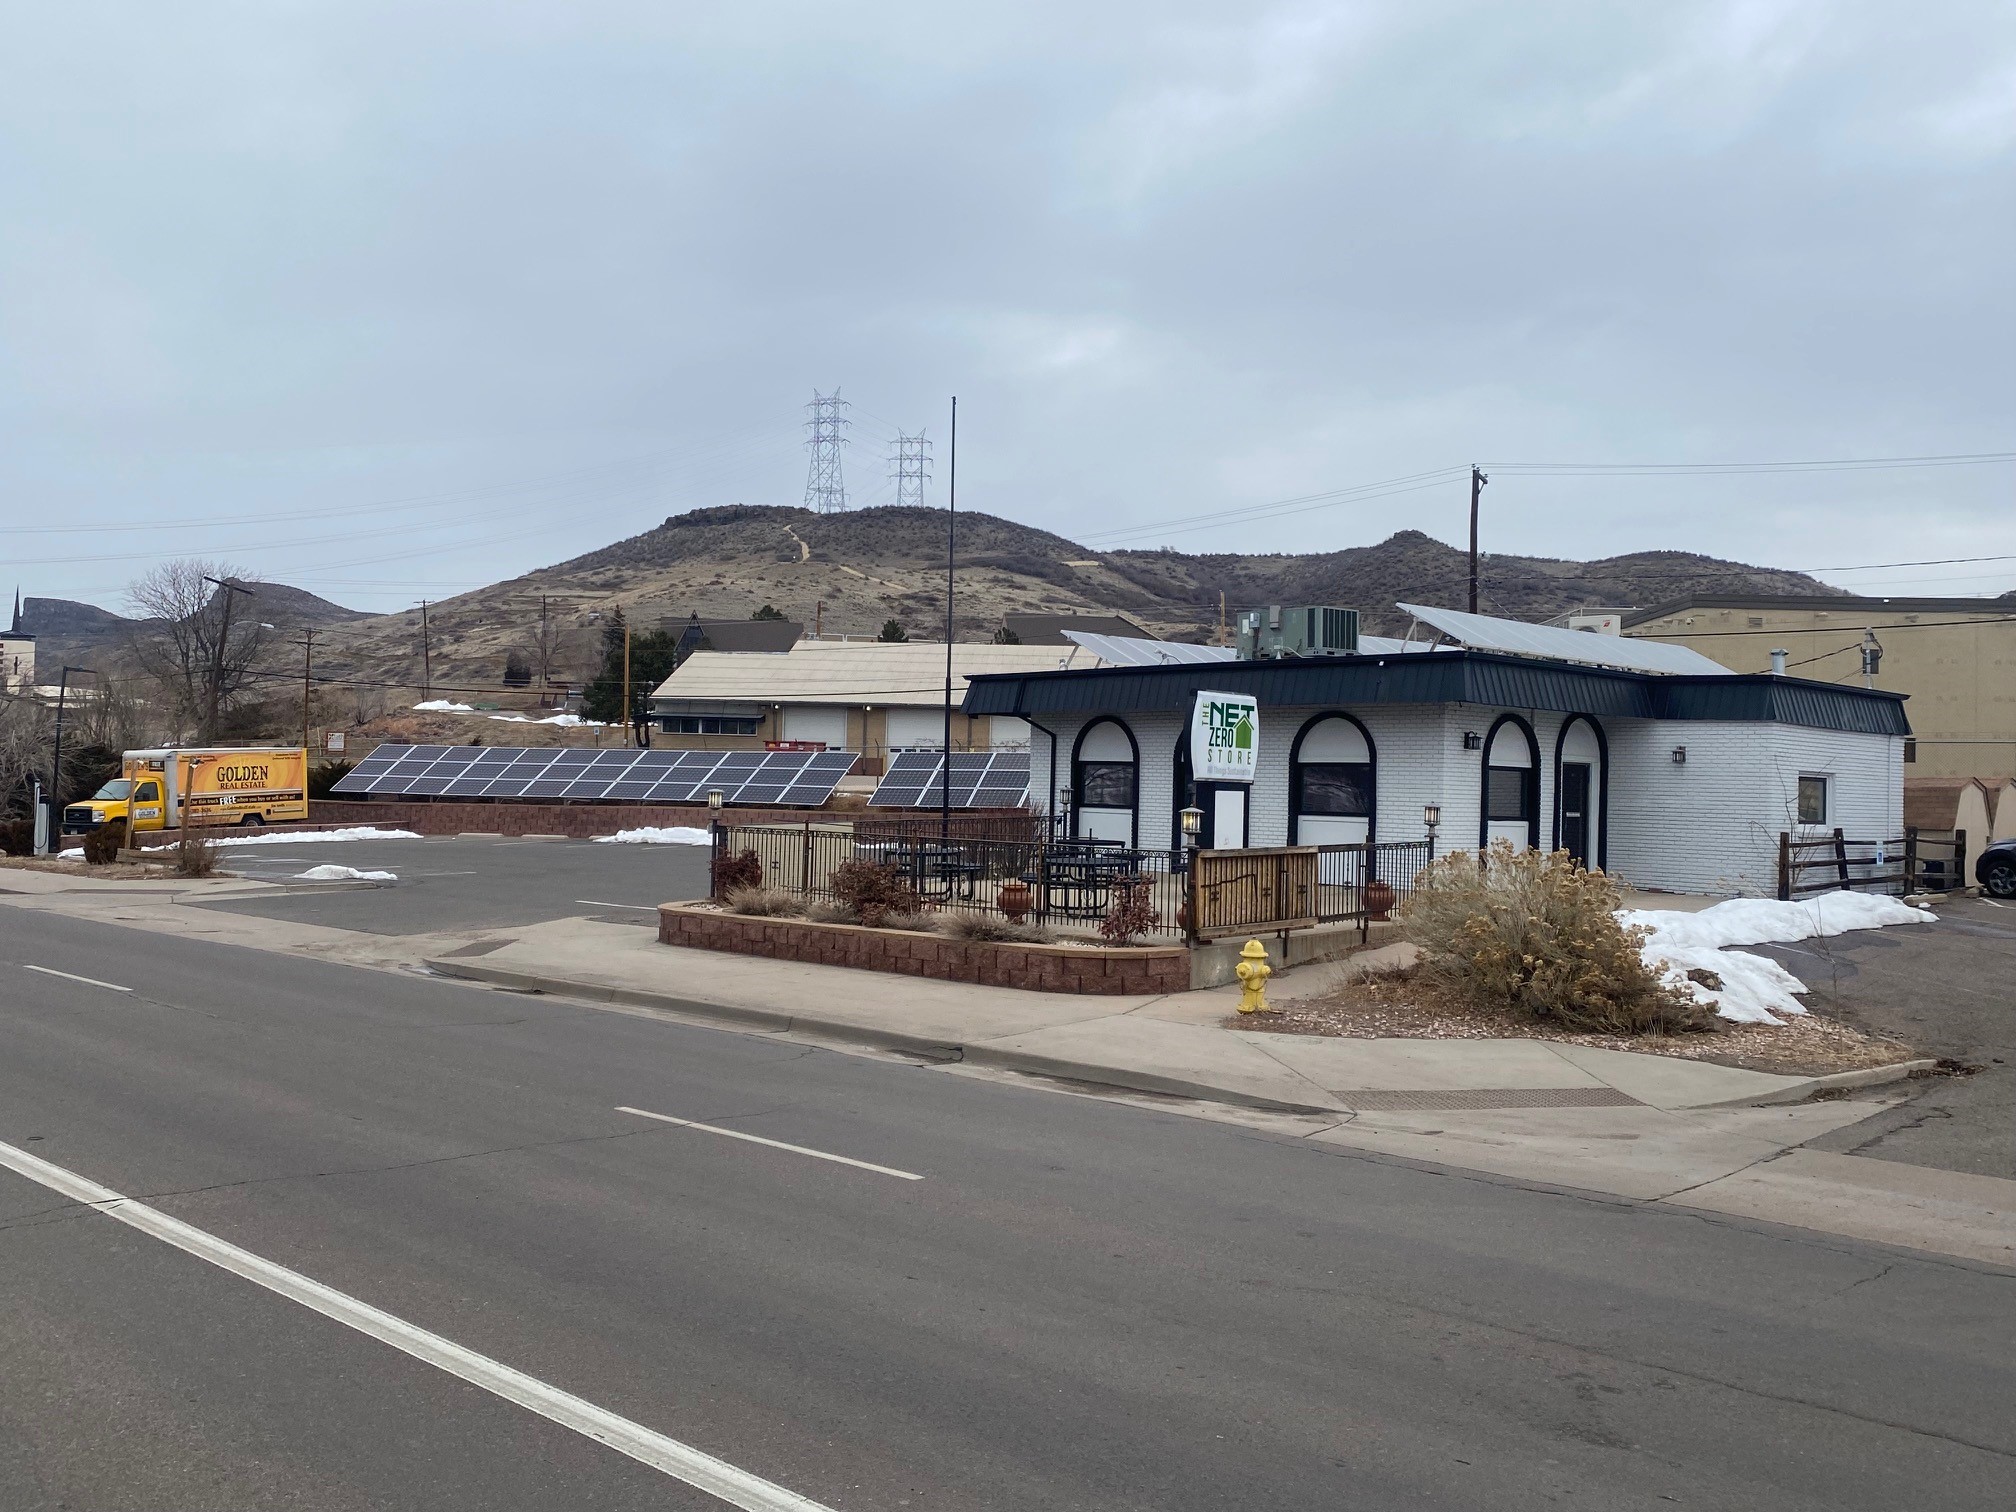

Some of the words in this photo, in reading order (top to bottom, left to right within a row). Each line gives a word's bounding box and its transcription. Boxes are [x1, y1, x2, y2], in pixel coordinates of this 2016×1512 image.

[1209, 701, 1255, 728] NET
[1209, 727, 1234, 748] ZERO
[1207, 748, 1251, 765] STORE
[217, 765, 269, 782] GOLDEN
[220, 782, 239, 790] REAL
[240, 781, 266, 789] ESTATE
[219, 795, 237, 806] FREE
